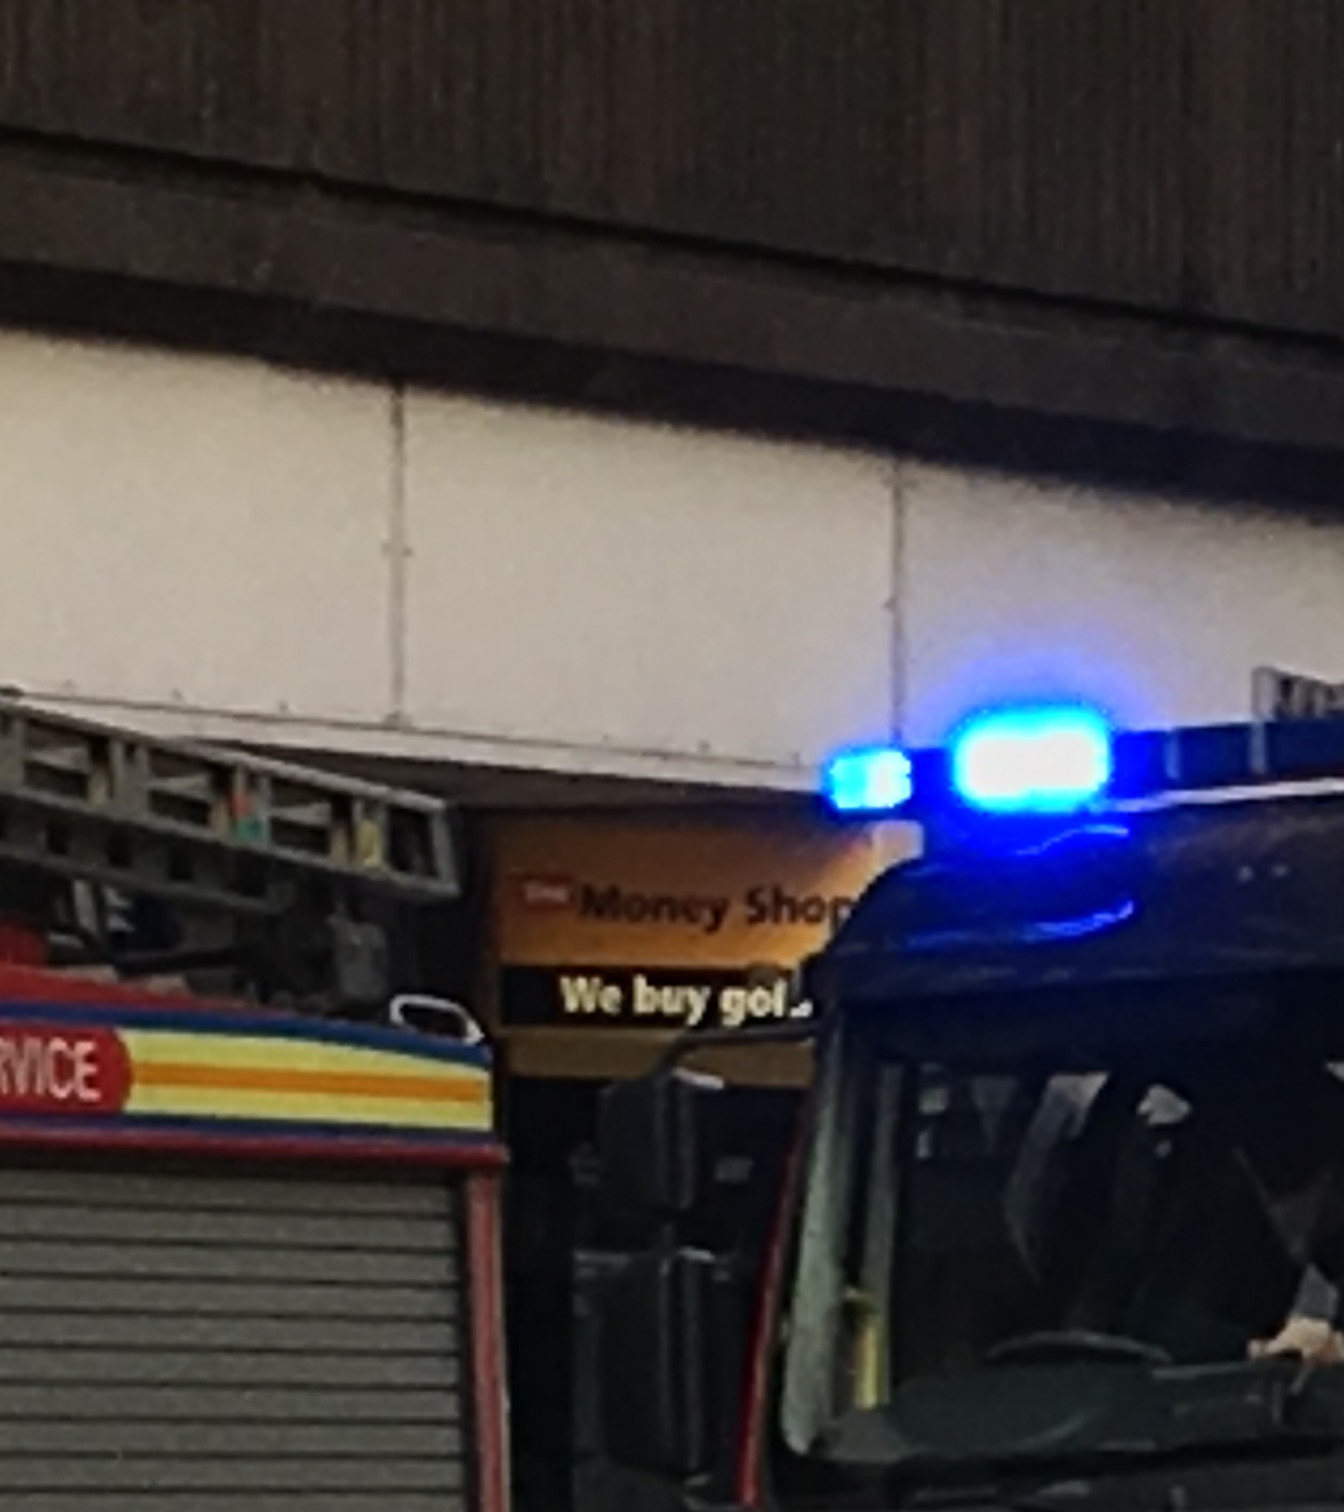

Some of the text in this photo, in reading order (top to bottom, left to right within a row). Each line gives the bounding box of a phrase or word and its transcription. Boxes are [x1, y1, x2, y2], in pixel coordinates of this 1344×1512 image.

[577, 883, 728, 933] Money
[559, 973, 813, 1026] We buy gol
